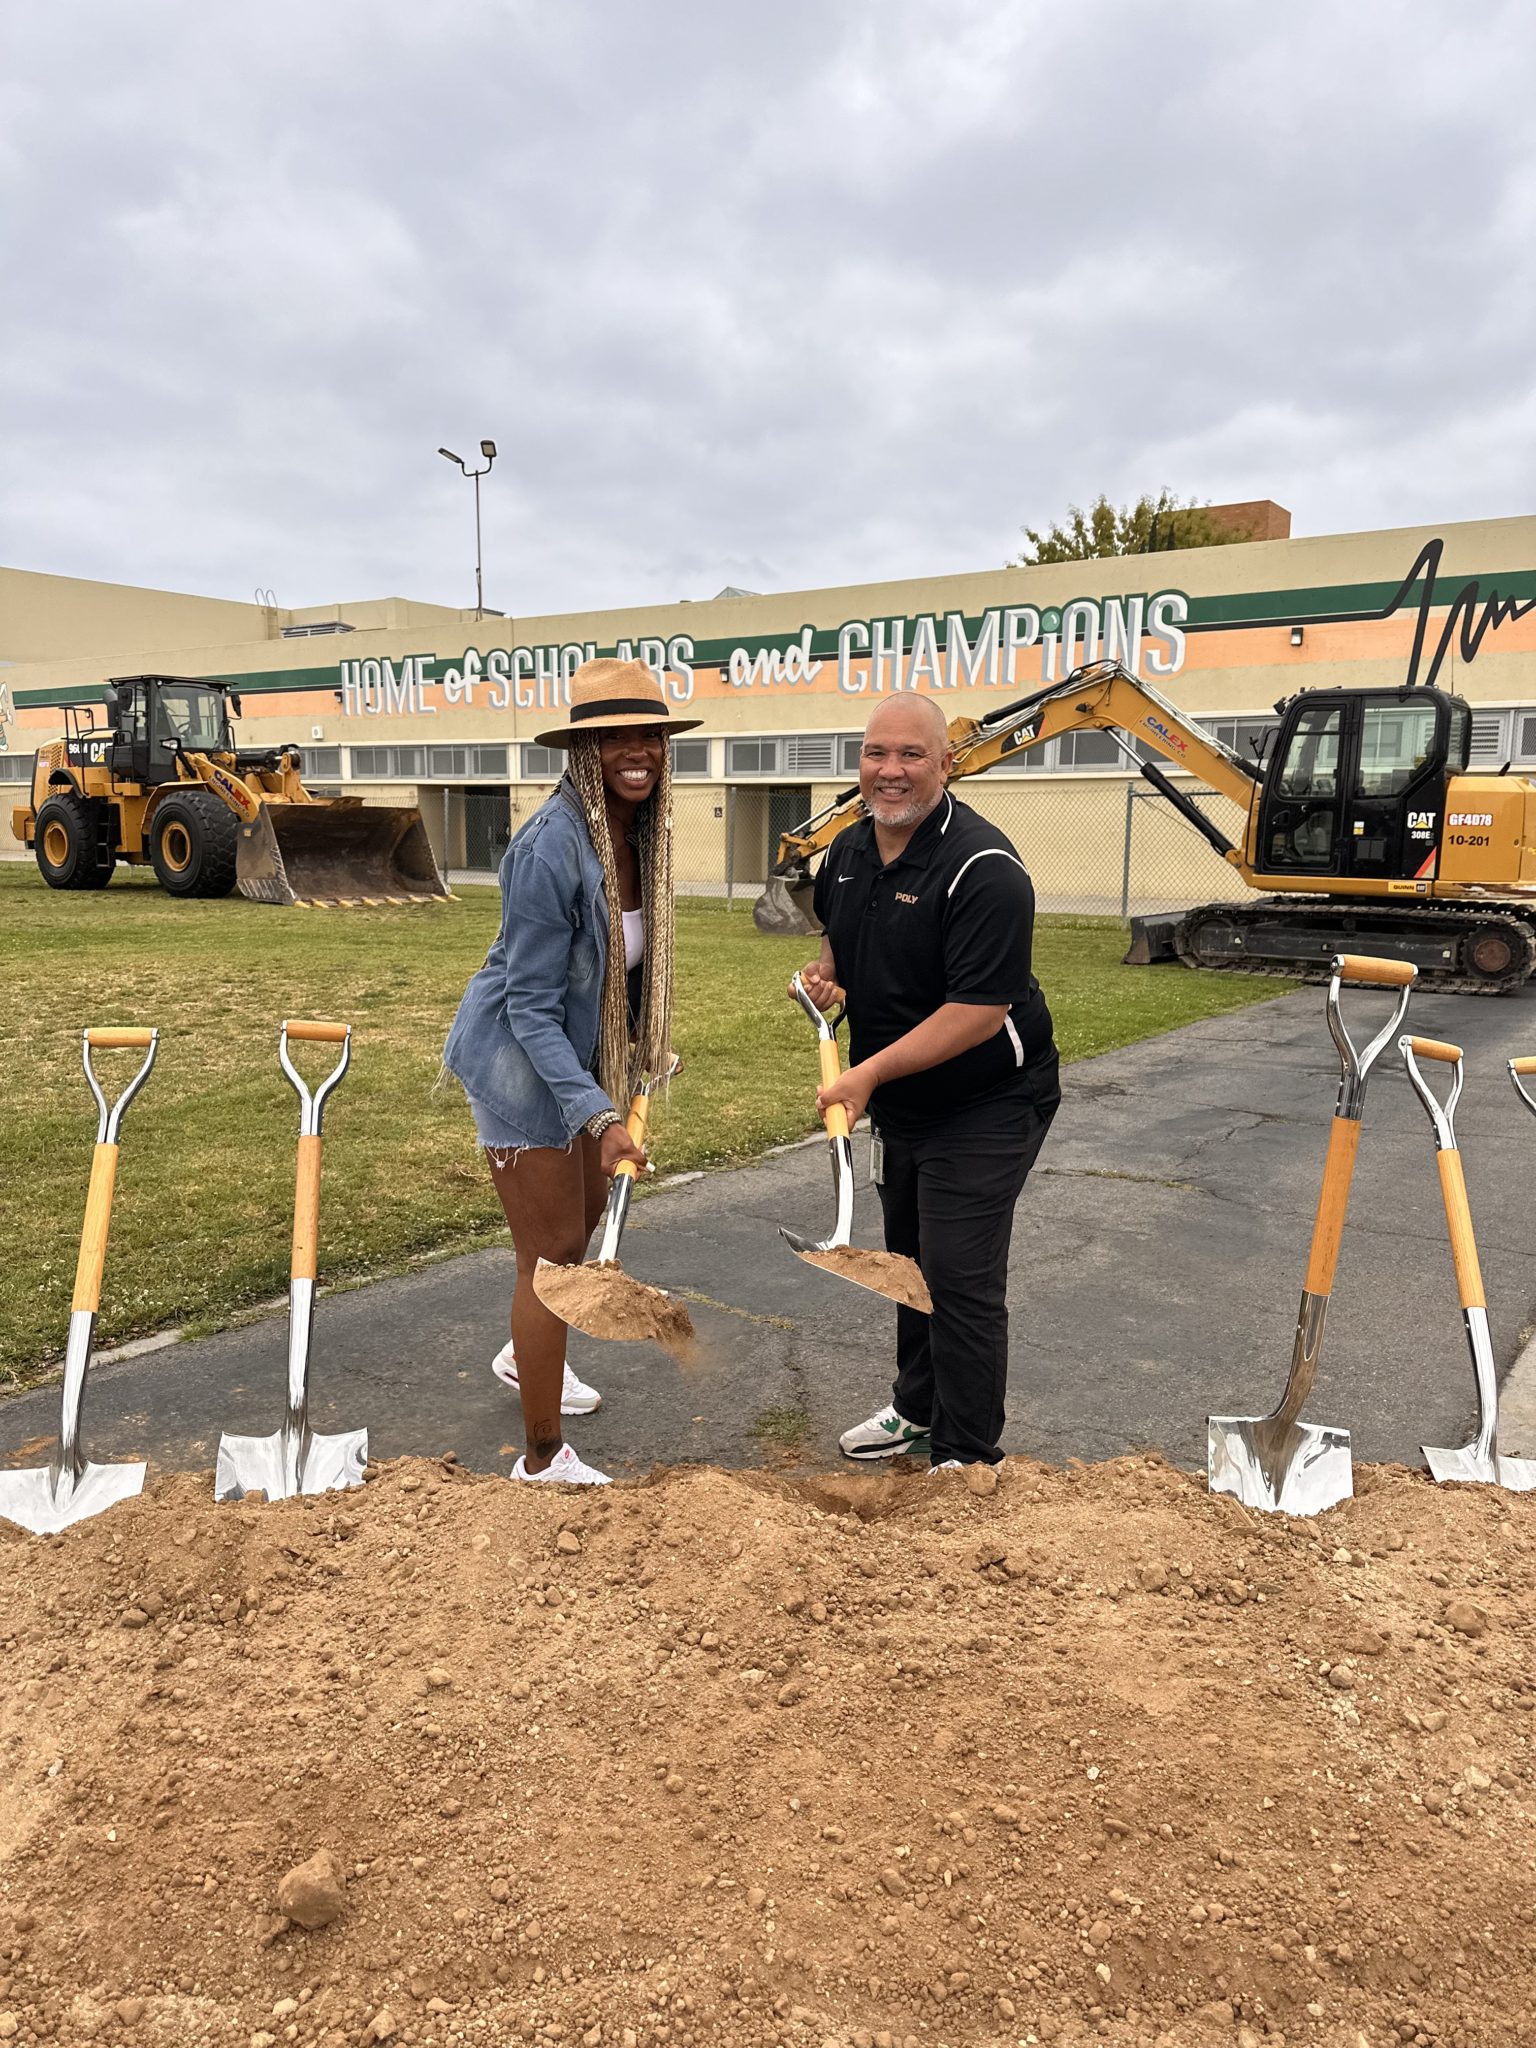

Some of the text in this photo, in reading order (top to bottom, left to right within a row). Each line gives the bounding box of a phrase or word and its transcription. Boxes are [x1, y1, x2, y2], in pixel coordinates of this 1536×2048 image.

[340, 656, 437, 716] HOME
[444, 648, 483, 704] of
[486, 636, 695, 709] SCHORS
[729, 627, 824, 688] and
[1013, 724, 1036, 746] CAT
[1147, 716, 1188, 752] CALEX
[214, 769, 251, 811] CALEX
[1407, 811, 1436, 829] CAT
[1448, 813, 1493, 827] GF4D78
[1448, 835, 1490, 847] 10-201
[895, 891, 919, 905] POLY
